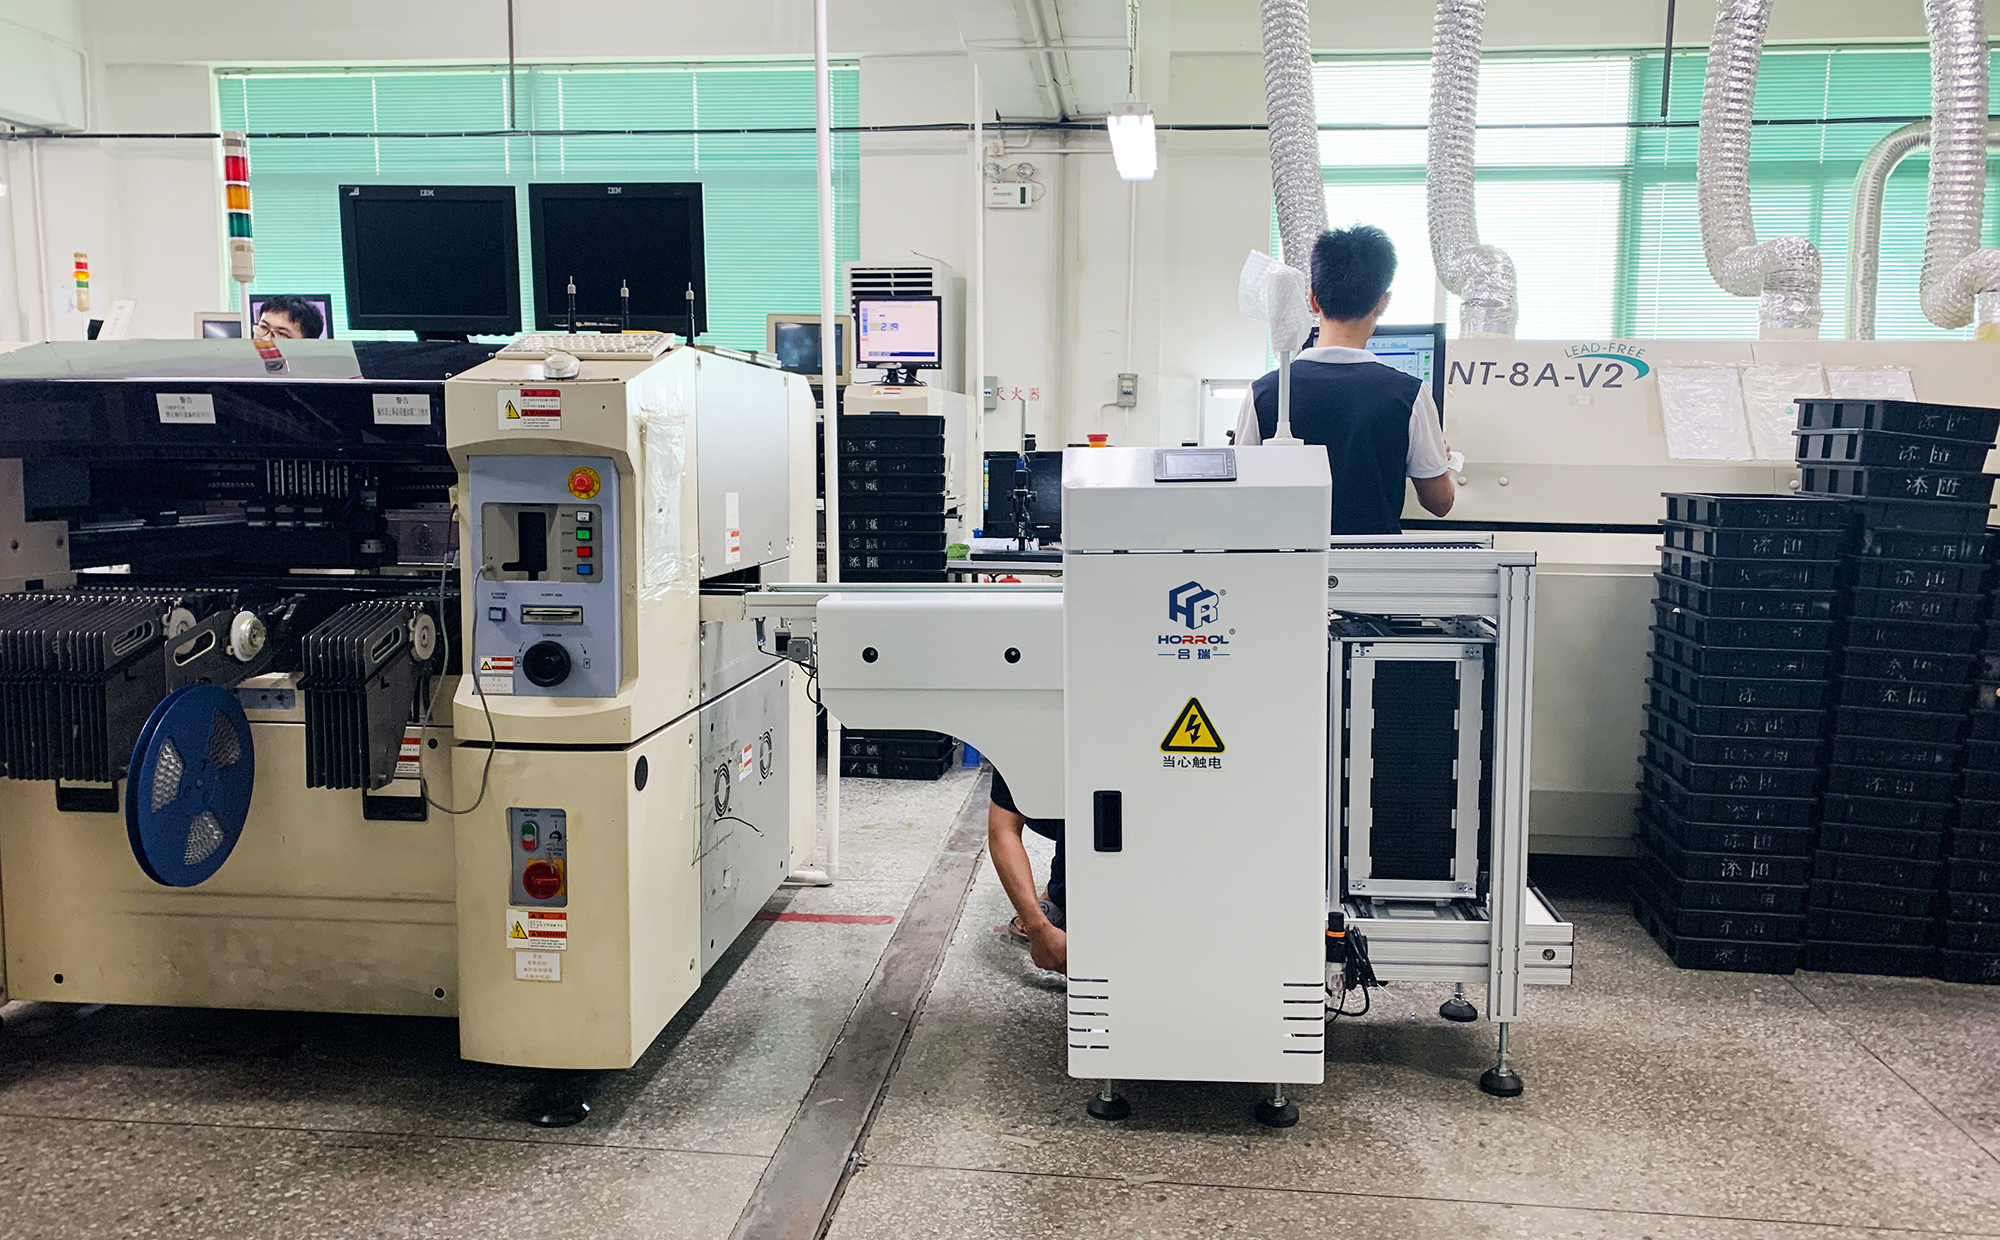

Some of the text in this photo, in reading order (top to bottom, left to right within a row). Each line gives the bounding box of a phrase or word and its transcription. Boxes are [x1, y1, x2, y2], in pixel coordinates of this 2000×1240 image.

[1564, 342, 1645, 359] LEAD-FREE
[1448, 361, 1624, 389] NT-8A-V2
[1158, 635, 1230, 645] HORROL
[1162, 755, 1222, 769] 当心触电
[536, 931, 566, 939] WARNING
